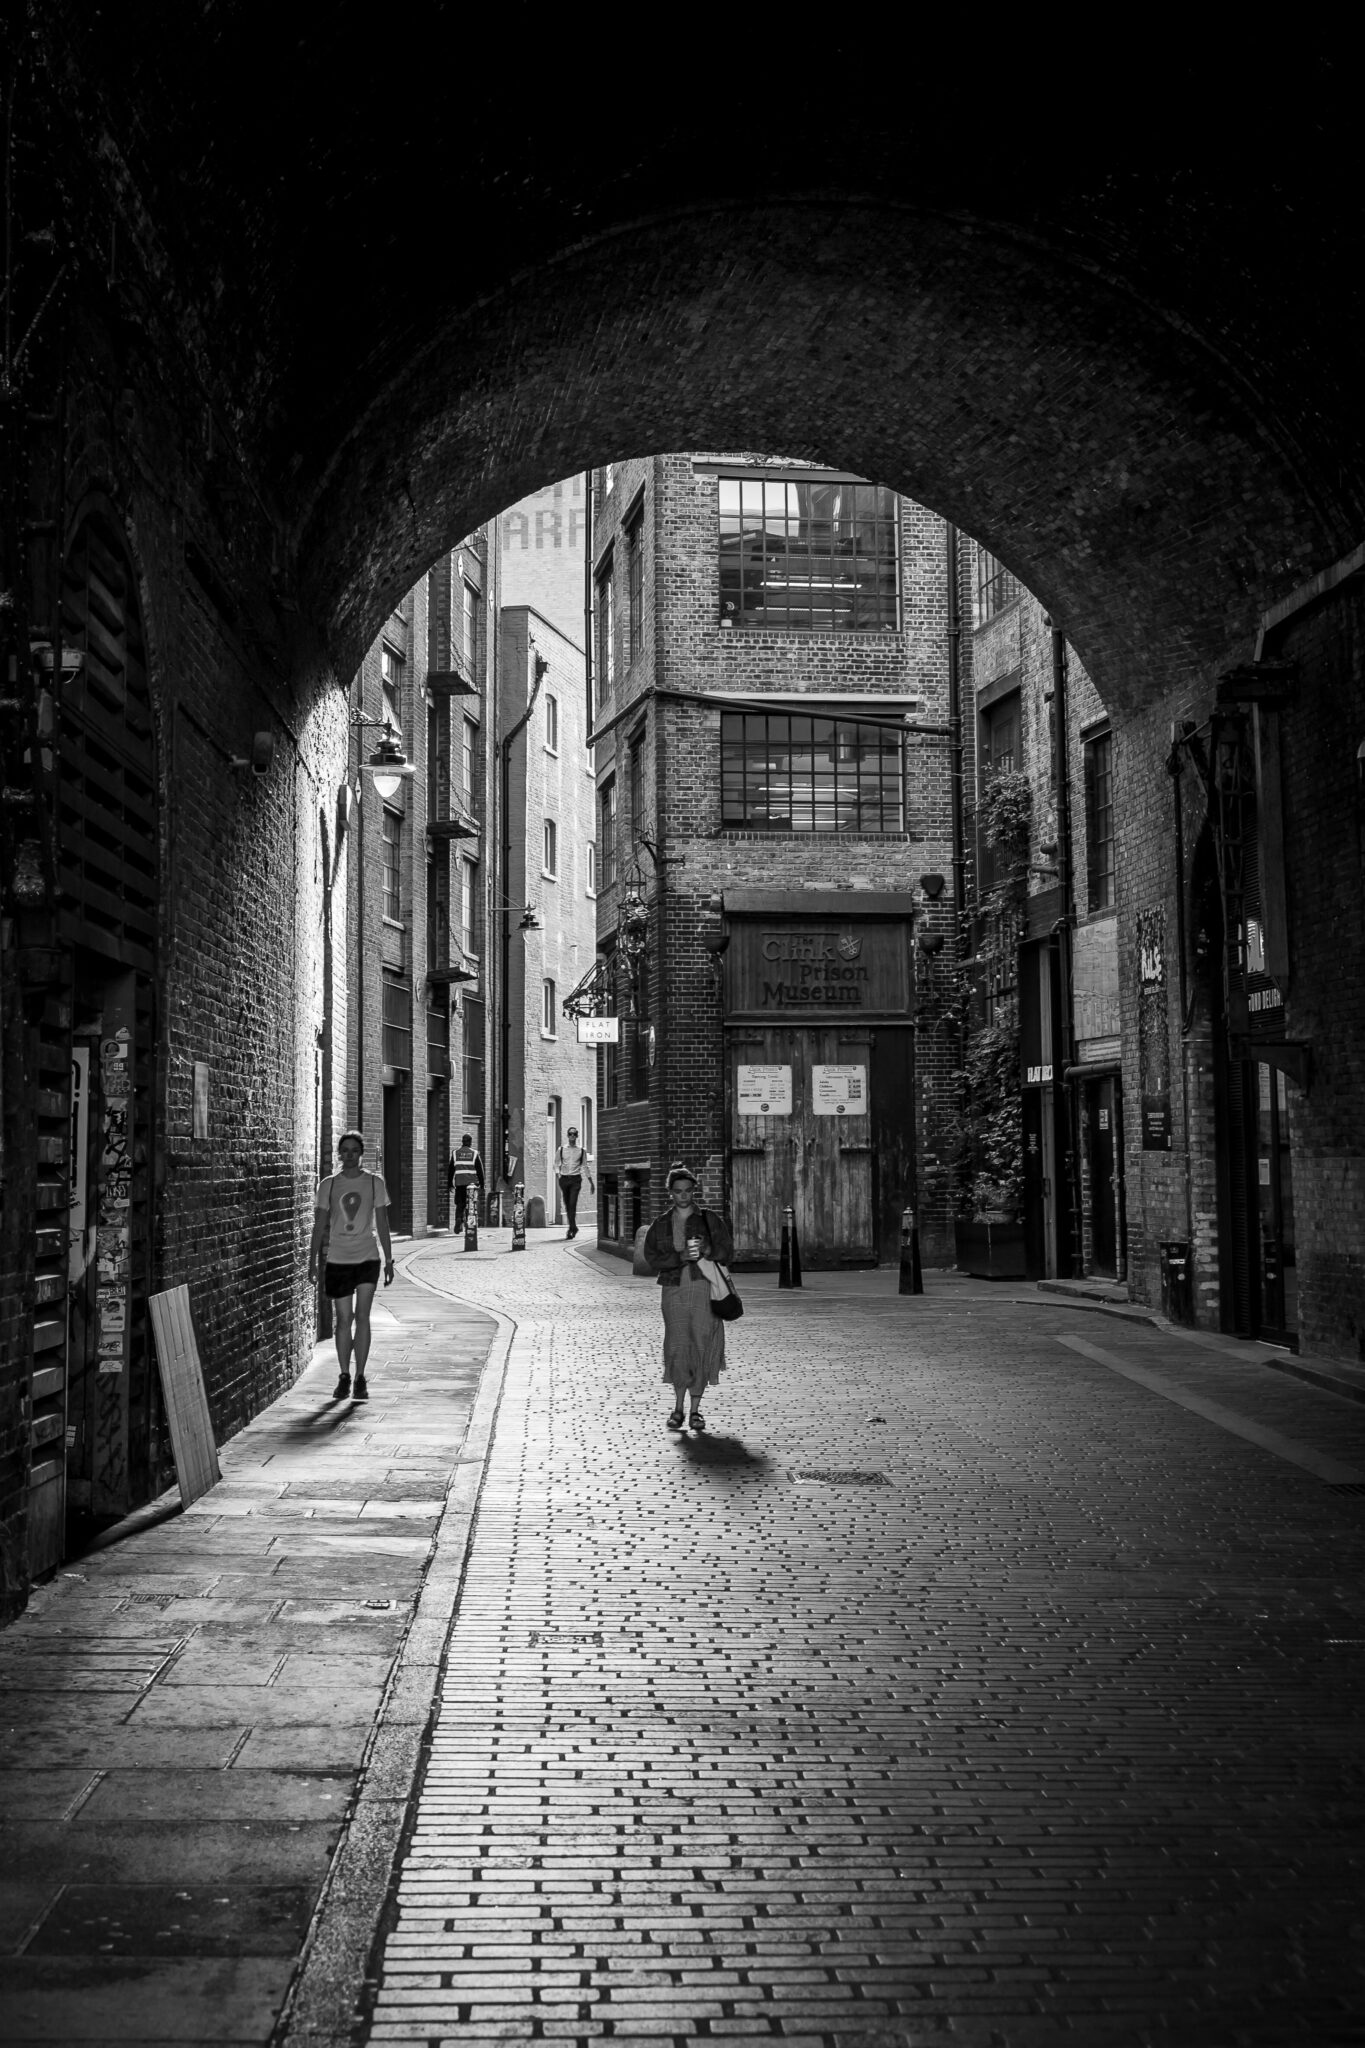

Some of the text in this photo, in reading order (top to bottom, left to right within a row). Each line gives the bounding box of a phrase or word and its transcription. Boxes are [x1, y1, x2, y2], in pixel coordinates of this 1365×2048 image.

[762, 938, 836, 962] Clink
[799, 964, 870, 985] Prison
[761, 981, 862, 1006] Museum
[585, 1031, 611, 1039] IRON
